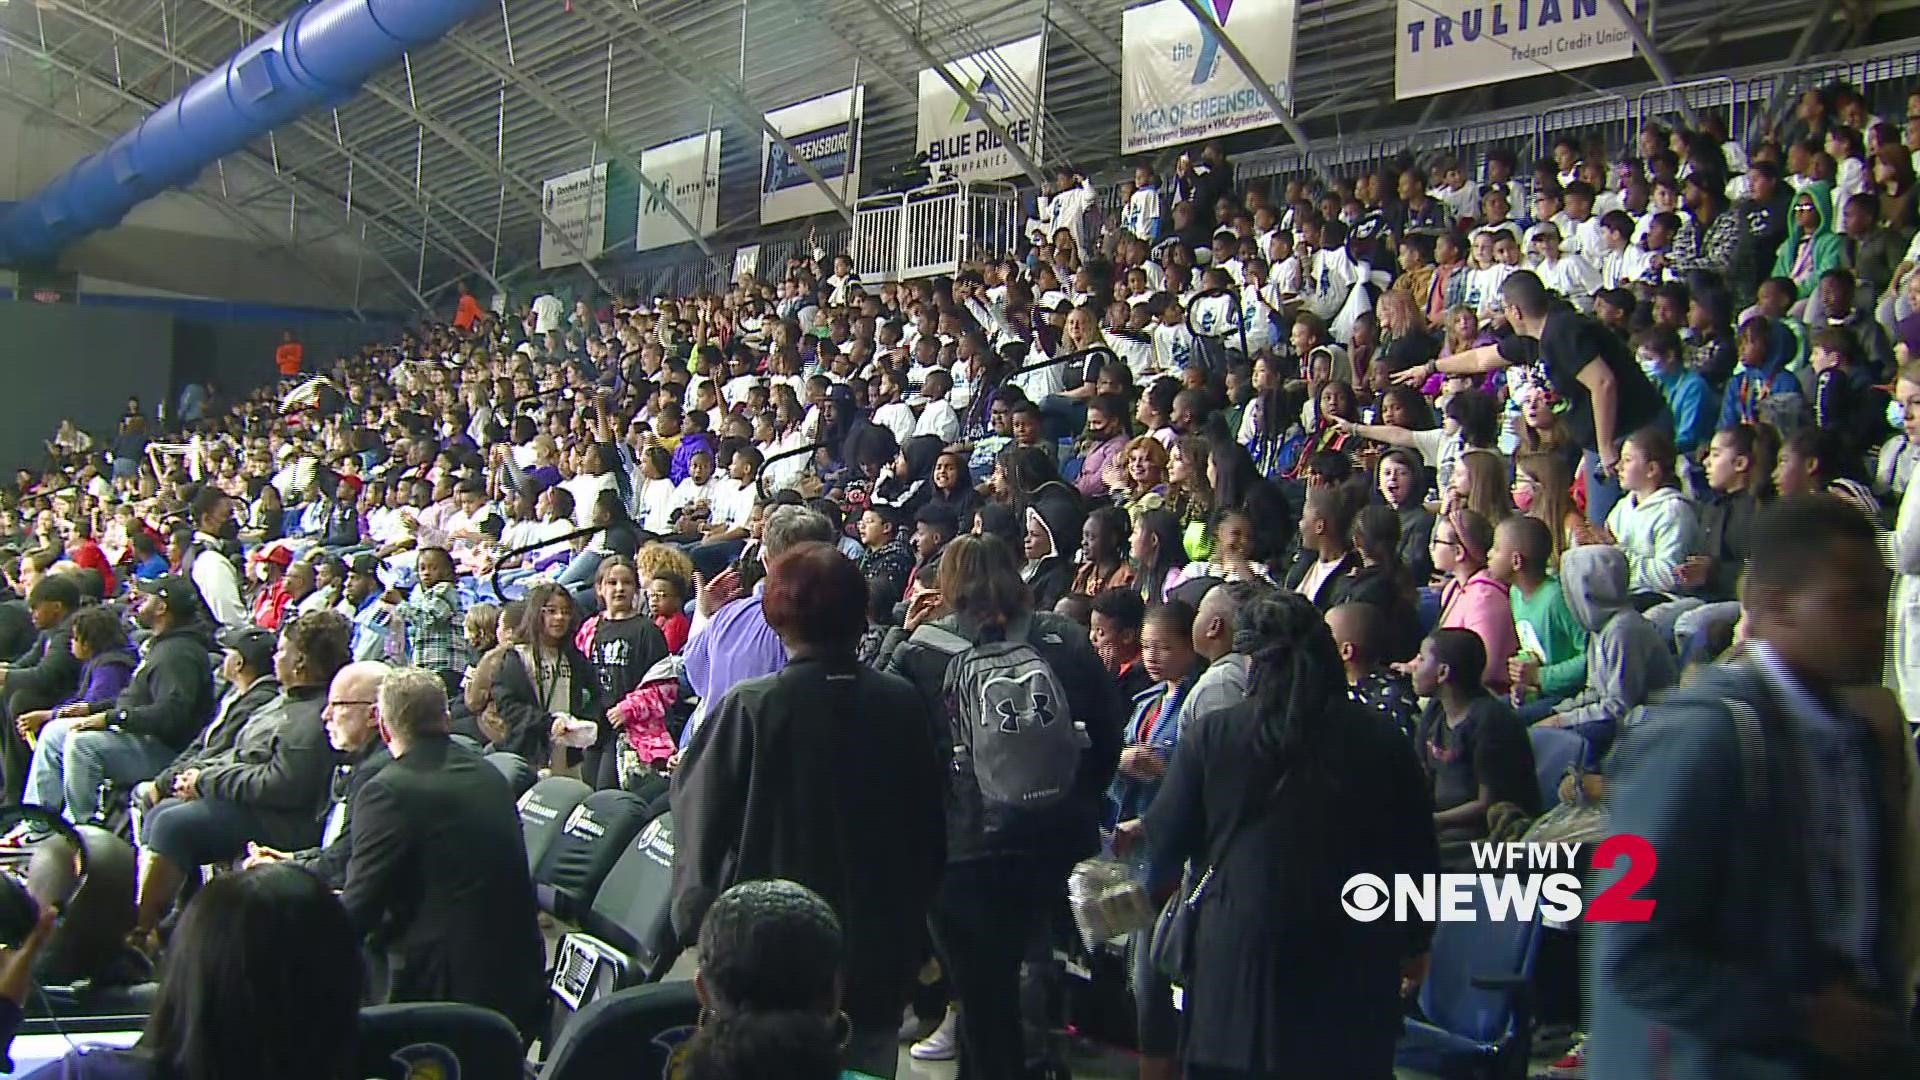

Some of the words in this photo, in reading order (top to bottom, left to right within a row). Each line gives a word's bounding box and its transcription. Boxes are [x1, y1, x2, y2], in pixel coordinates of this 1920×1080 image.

[1408, 0, 1598, 53] TRULIAN
[1173, 42, 1192, 61] the
[1511, 40, 1552, 61] Federal
[1556, 34, 1592, 53] Credit
[1596, 28, 1631, 45] Union
[1131, 107, 1166, 134] YMCA
[1170, 103, 1187, 126] OF
[929, 132, 970, 163] BLUE
[954, 153, 1008, 175] OMPANIES
[737, 252, 755, 277] 104
